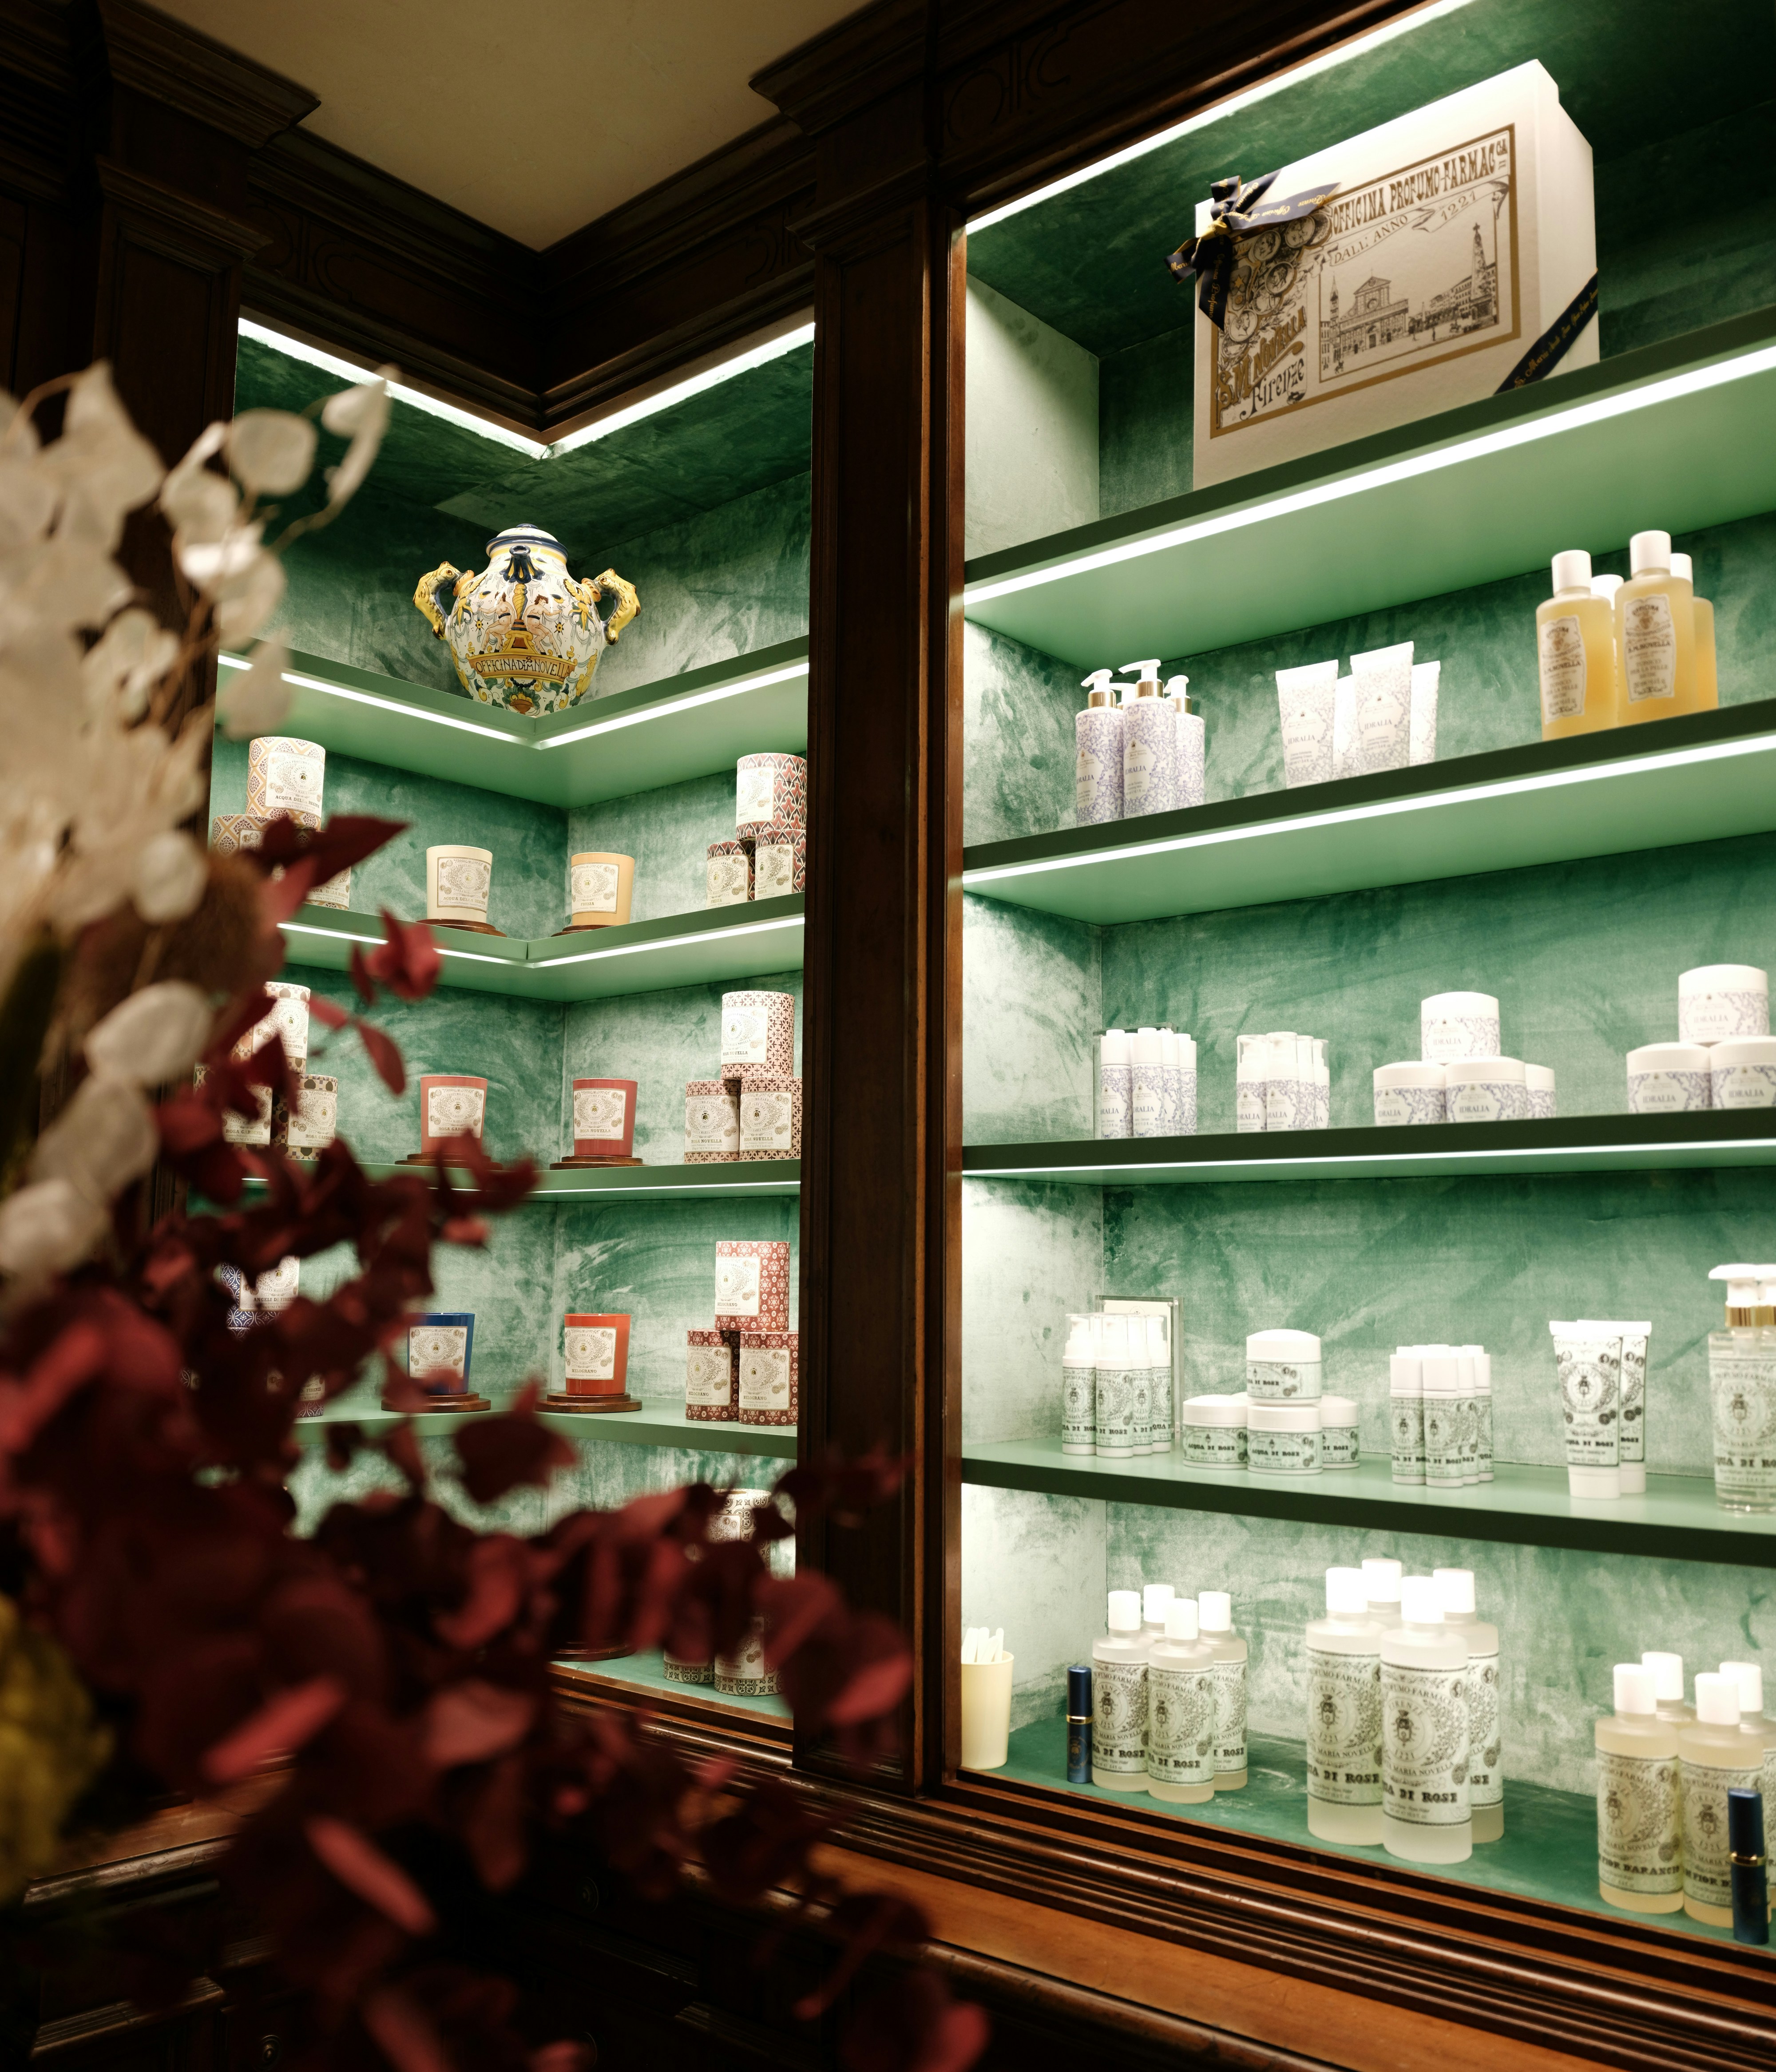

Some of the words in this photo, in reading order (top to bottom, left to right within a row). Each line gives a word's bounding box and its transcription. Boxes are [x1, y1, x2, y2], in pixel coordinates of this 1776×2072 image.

[1332, 187, 1386, 235] OFFICINA
[1335, 237, 1368, 264] DALL'
[1374, 215, 1408, 243] ANNO
[1441, 190, 1476, 221] 1221
[1253, 305, 1307, 382] NOVELLA
[1240, 358, 1304, 421] Firenze
[1364, 719, 1392, 730] IDRALIA
[1288, 735, 1316, 745] IDRALIA
[1693, 1014, 1728, 1023] IDRALIA
[1433, 1037, 1462, 1046] IDRALIA
[1643, 1094, 1677, 1103] IDRALIA
[1728, 1088, 1764, 1098] IDRALIA
[1459, 1105, 1490, 1113] IDRALIA
[1740, 1458, 1755, 1468] DI
[1096, 1684, 1122, 1697] FIRENZE
[1313, 1684, 1347, 1701] FIRENZE
[1389, 1700, 1424, 1716] FIRENZE
[1117, 1728, 1143, 1739] NOVELLA
[1221, 1726, 1243, 1740] NOVELLA
[1319, 1731, 1338, 1742] 1221
[1171, 1738, 1198, 1749] NOVELLA
[1103, 1748, 1114, 1757] DI
[1118, 1749, 1145, 1758] ROSE
[1223, 1747, 1245, 1757] ROSE
[1317, 1747, 1340, 1758] MARIA
[1342, 1743, 1376, 1757] NOVELLA
[1395, 1749, 1415, 1759] 1221
[1158, 1757, 1168, 1766] DI
[1173, 1759, 1201, 1768] ROSE
[1392, 1765, 1416, 1775] MARIA
[1420, 1761, 1454, 1775] NOVELLA
[1324, 1770, 1338, 1782] DI
[1345, 1772, 1380, 1784] ROSE
[1399, 1788, 1415, 1801] DI
[1422, 1791, 1458, 1803] ROSE
[1627, 1839, 1661, 1851] NOVELLA
[1700, 1841, 1720, 1851] 1221
[1693, 1872, 1718, 1886] FIOR
